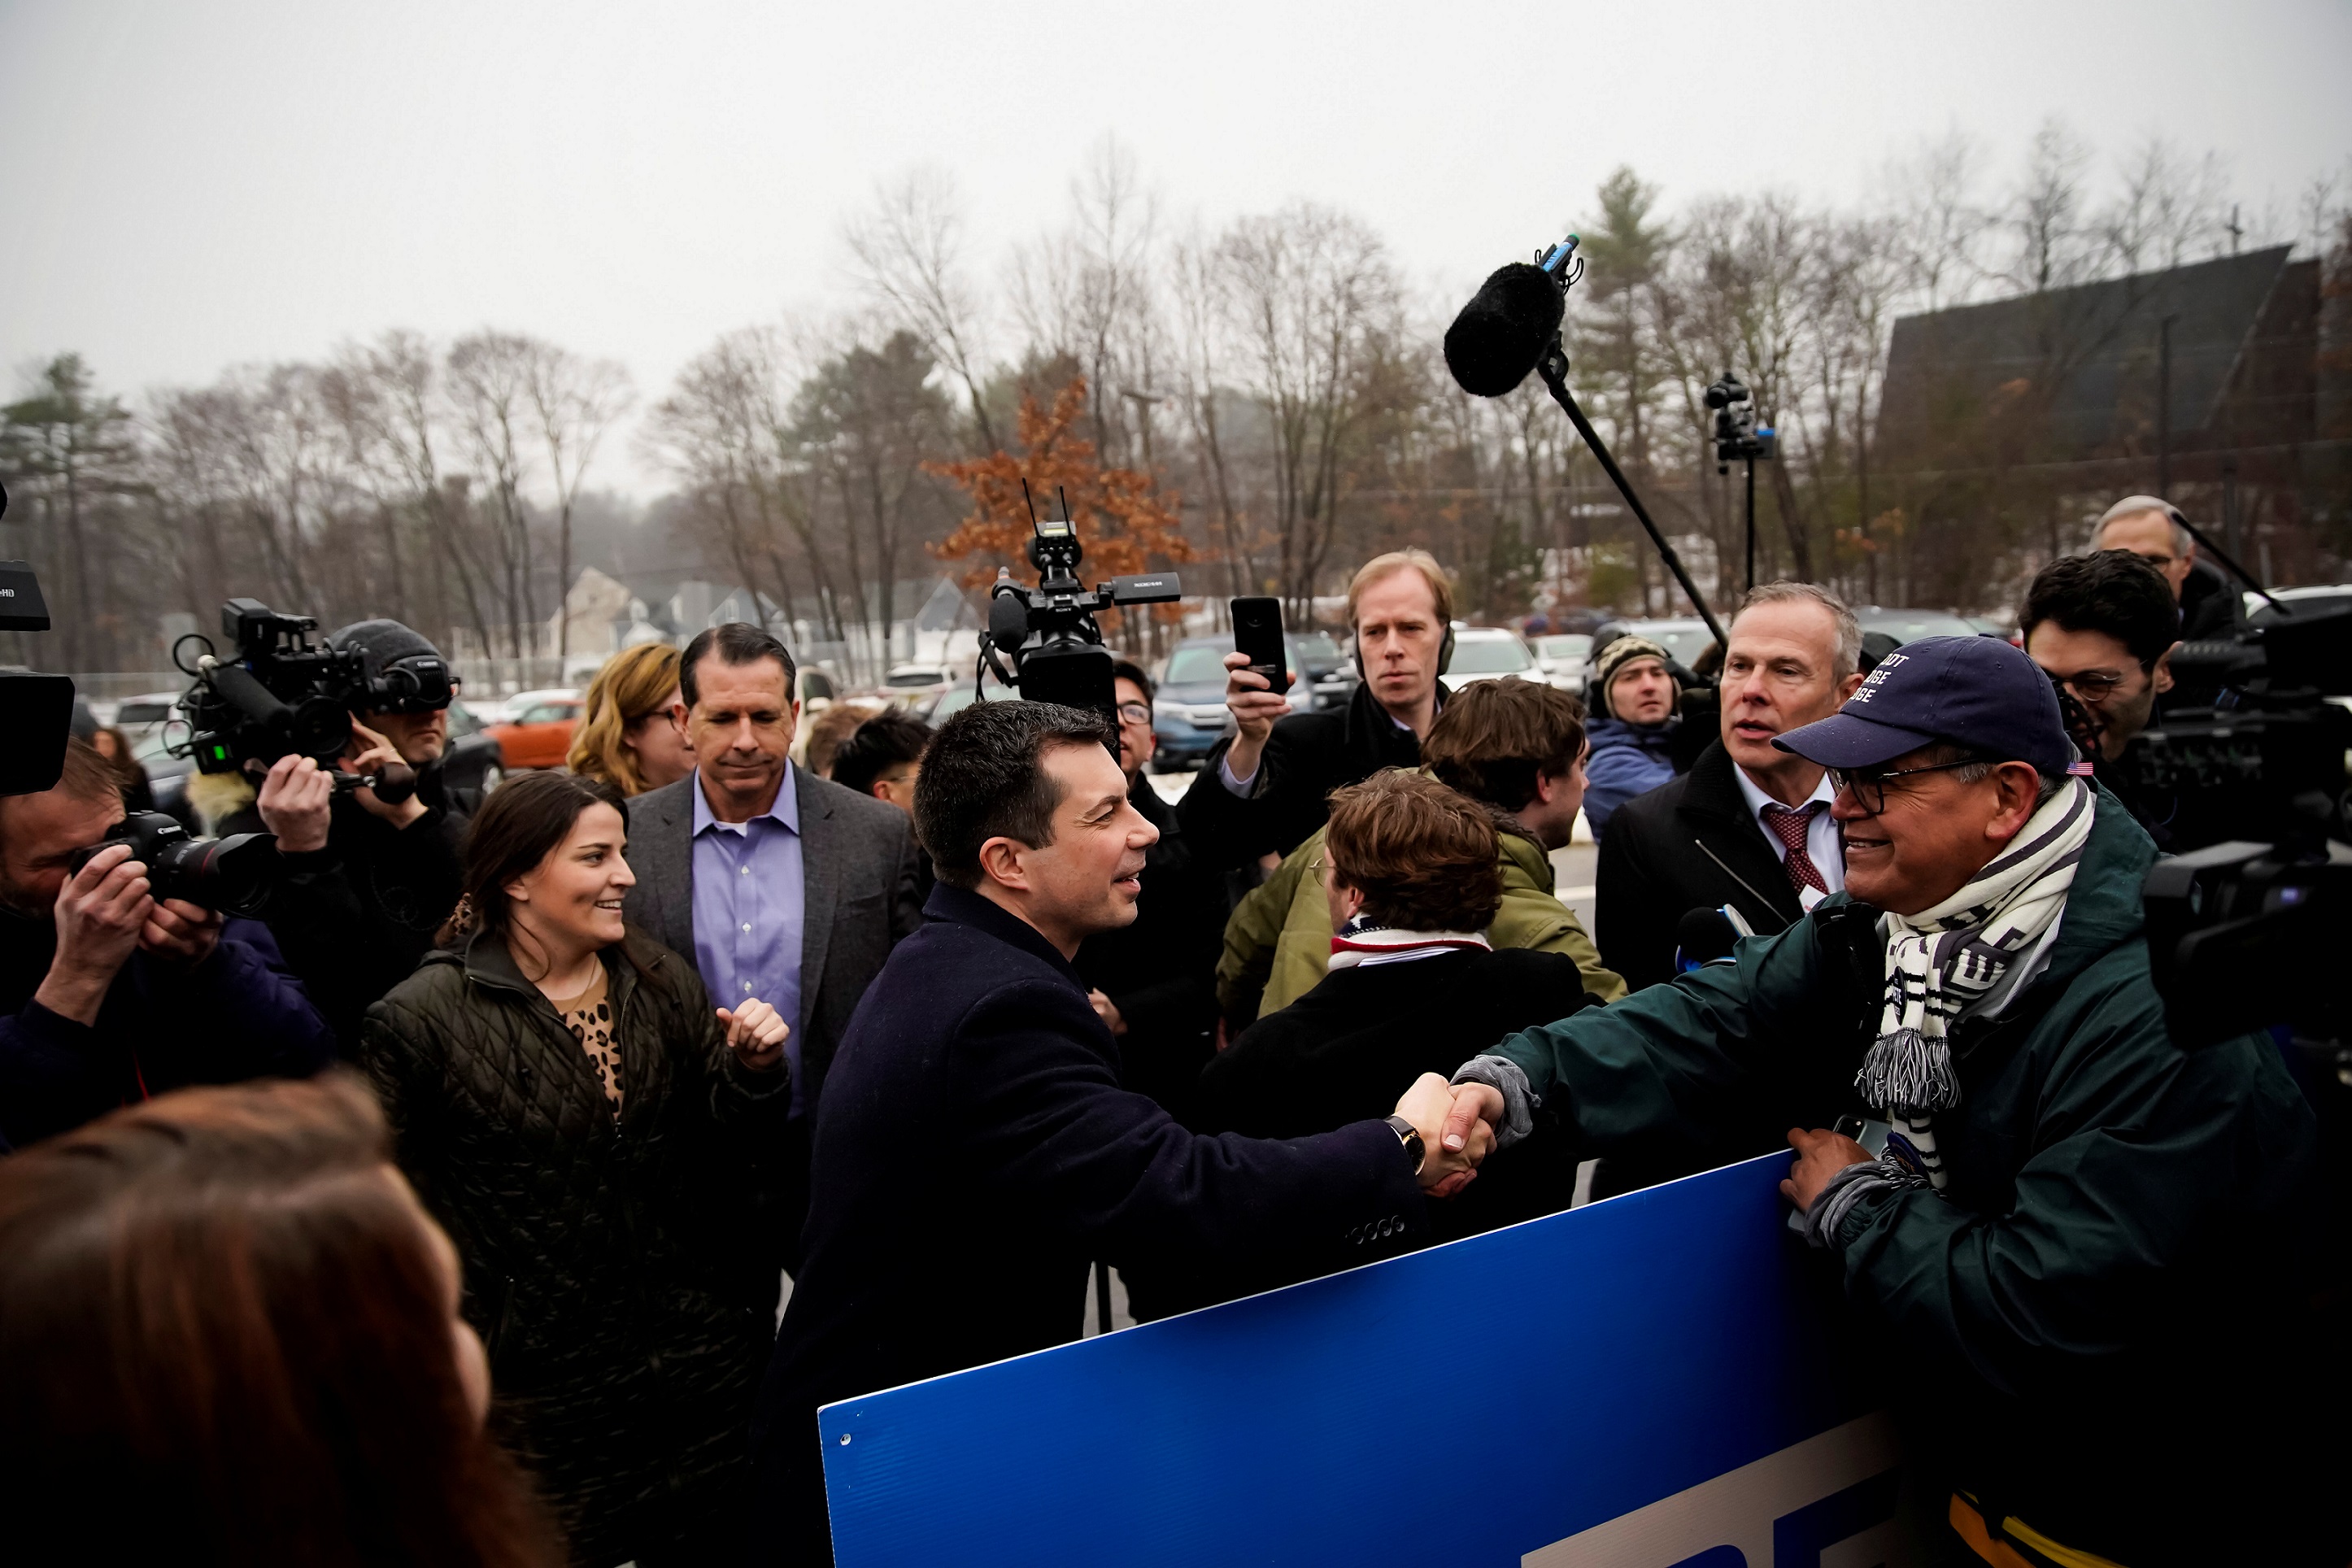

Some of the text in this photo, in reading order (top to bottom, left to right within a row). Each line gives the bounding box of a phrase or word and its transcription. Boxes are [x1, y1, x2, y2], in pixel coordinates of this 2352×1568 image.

[1879, 653, 1910, 668] OOT
[1863, 669, 1892, 685] DGE
[1850, 687, 1877, 703] DGE
